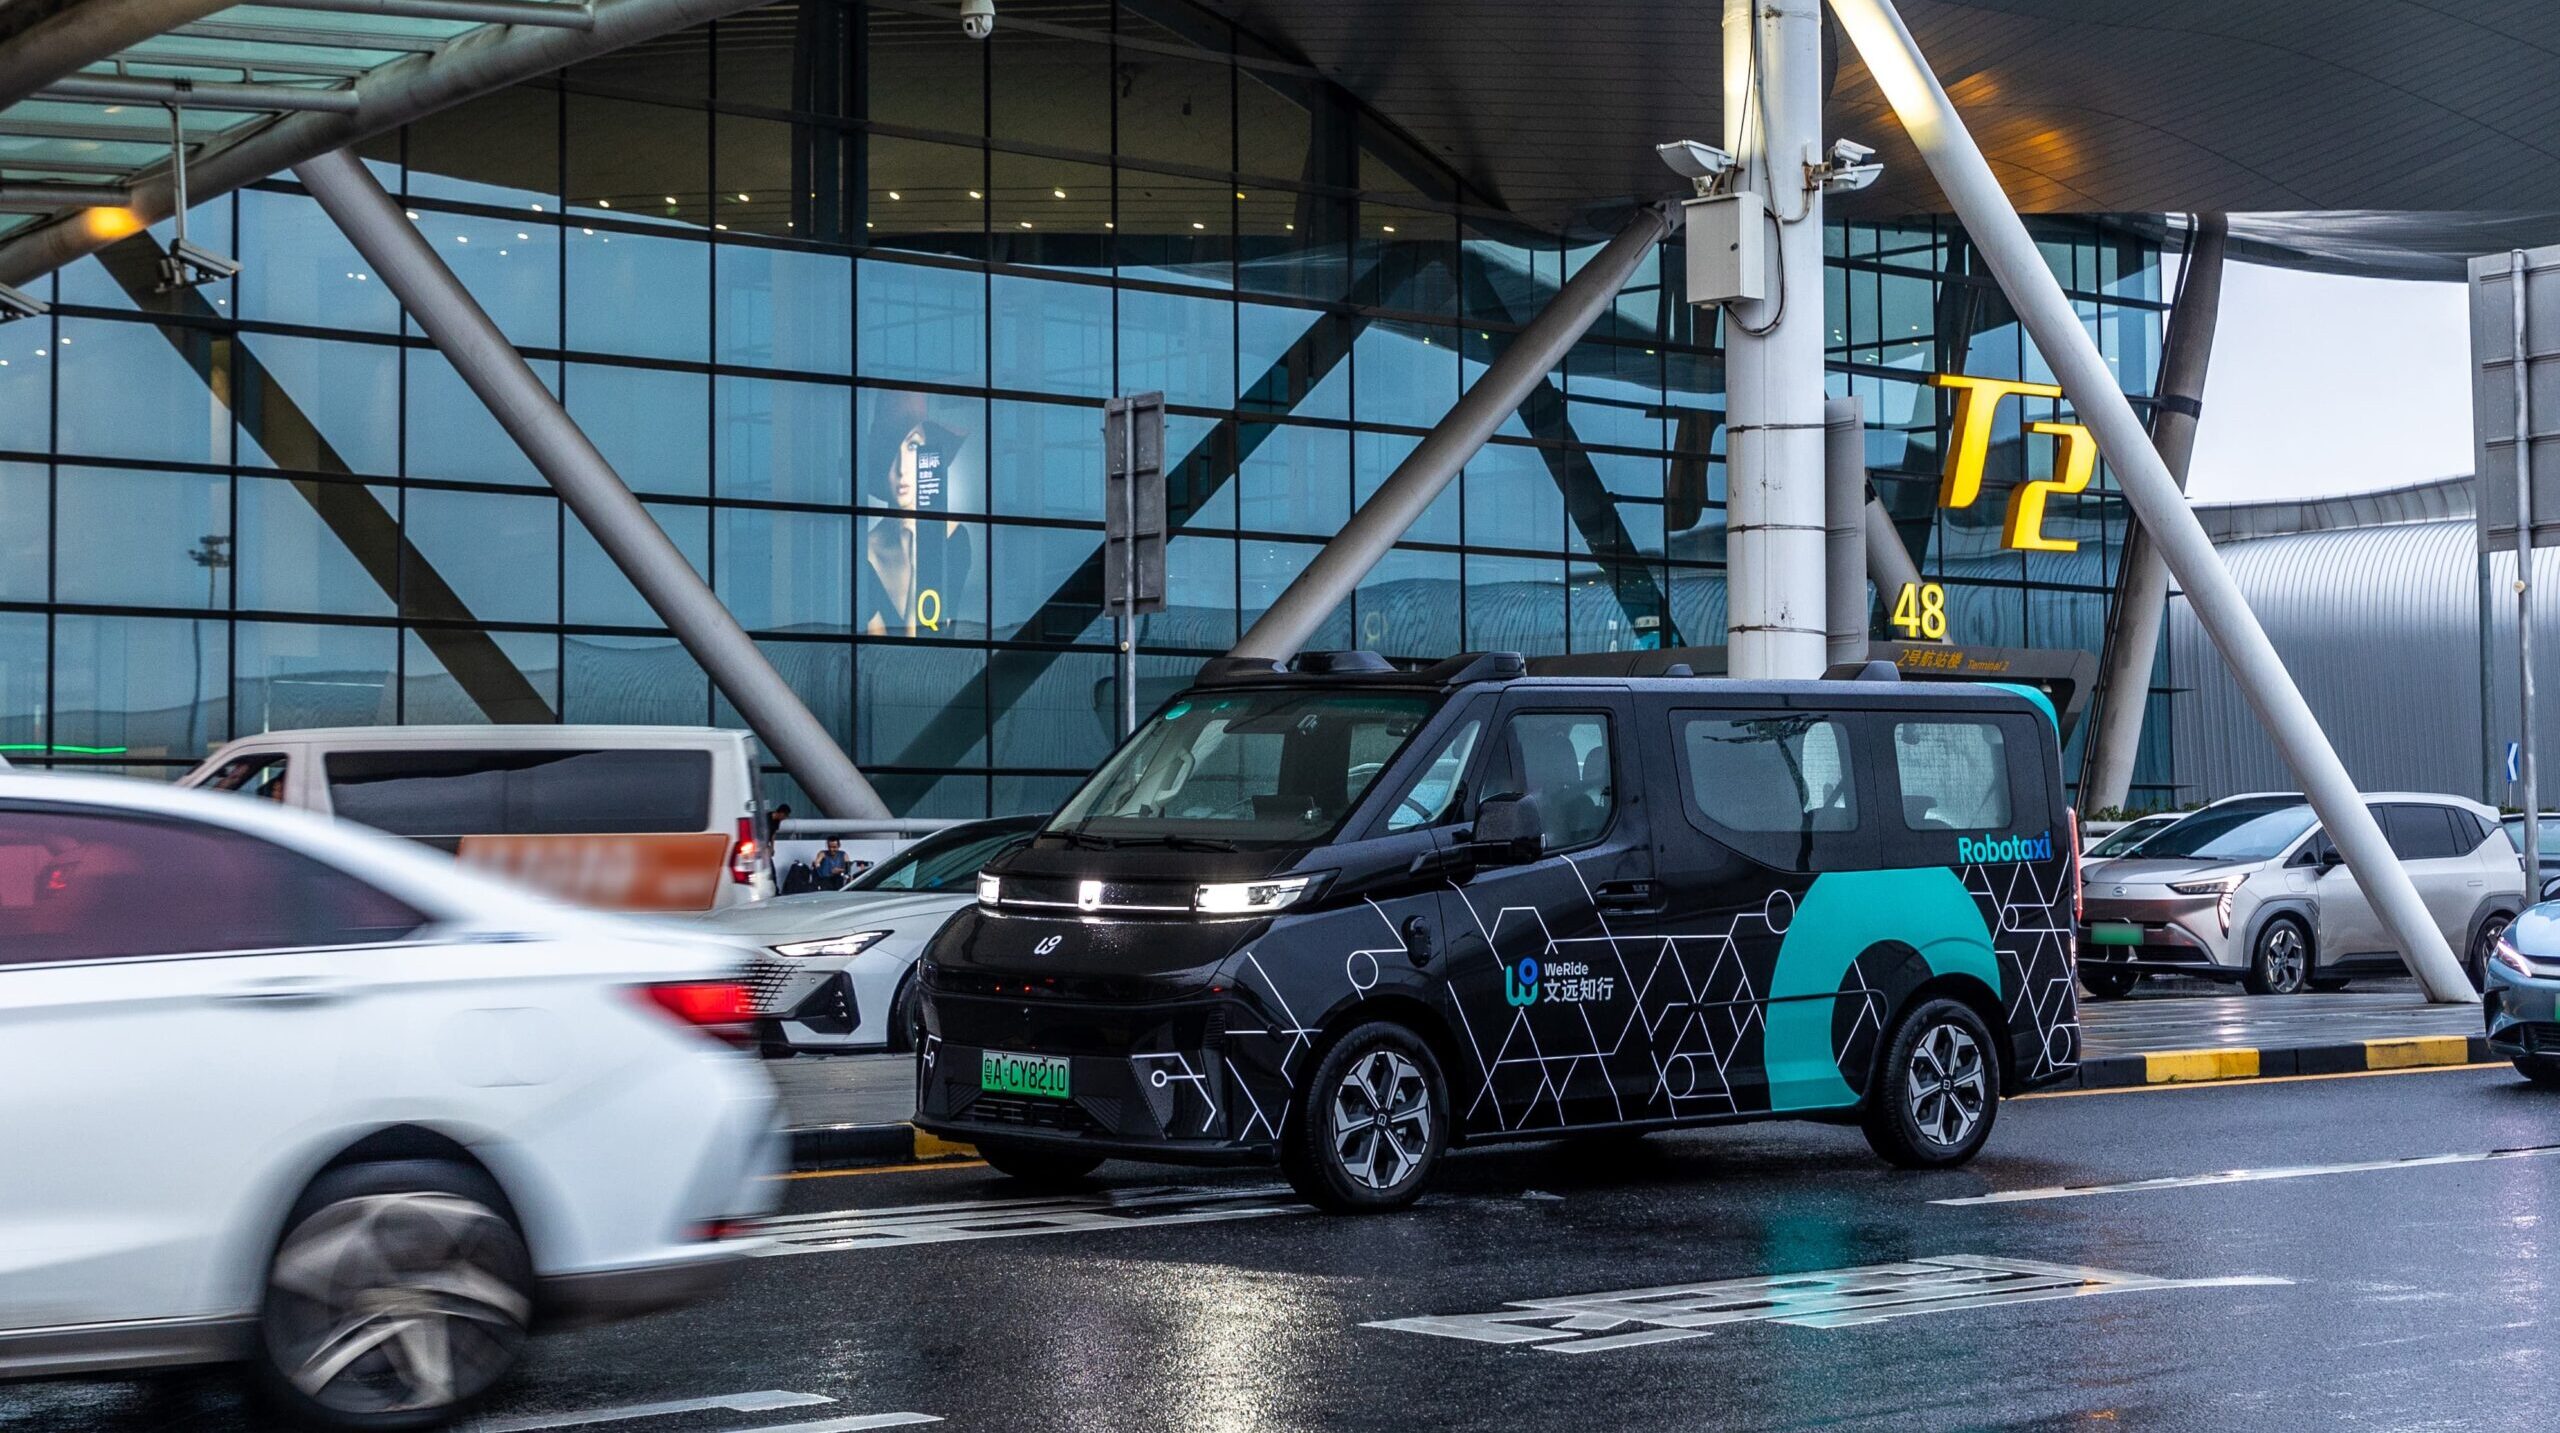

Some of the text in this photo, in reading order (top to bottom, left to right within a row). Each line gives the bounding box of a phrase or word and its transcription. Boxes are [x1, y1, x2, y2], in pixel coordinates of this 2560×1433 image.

[1928, 373, 2098, 552] T2
[917, 589, 941, 632] Q
[1893, 582, 1947, 640] 48
[1967, 659, 2001, 671] Terminal
[1958, 830, 2051, 864] Robotaxi
[1544, 961, 1589, 977] WeRide
[1543, 977, 1614, 1003] 文远知行
